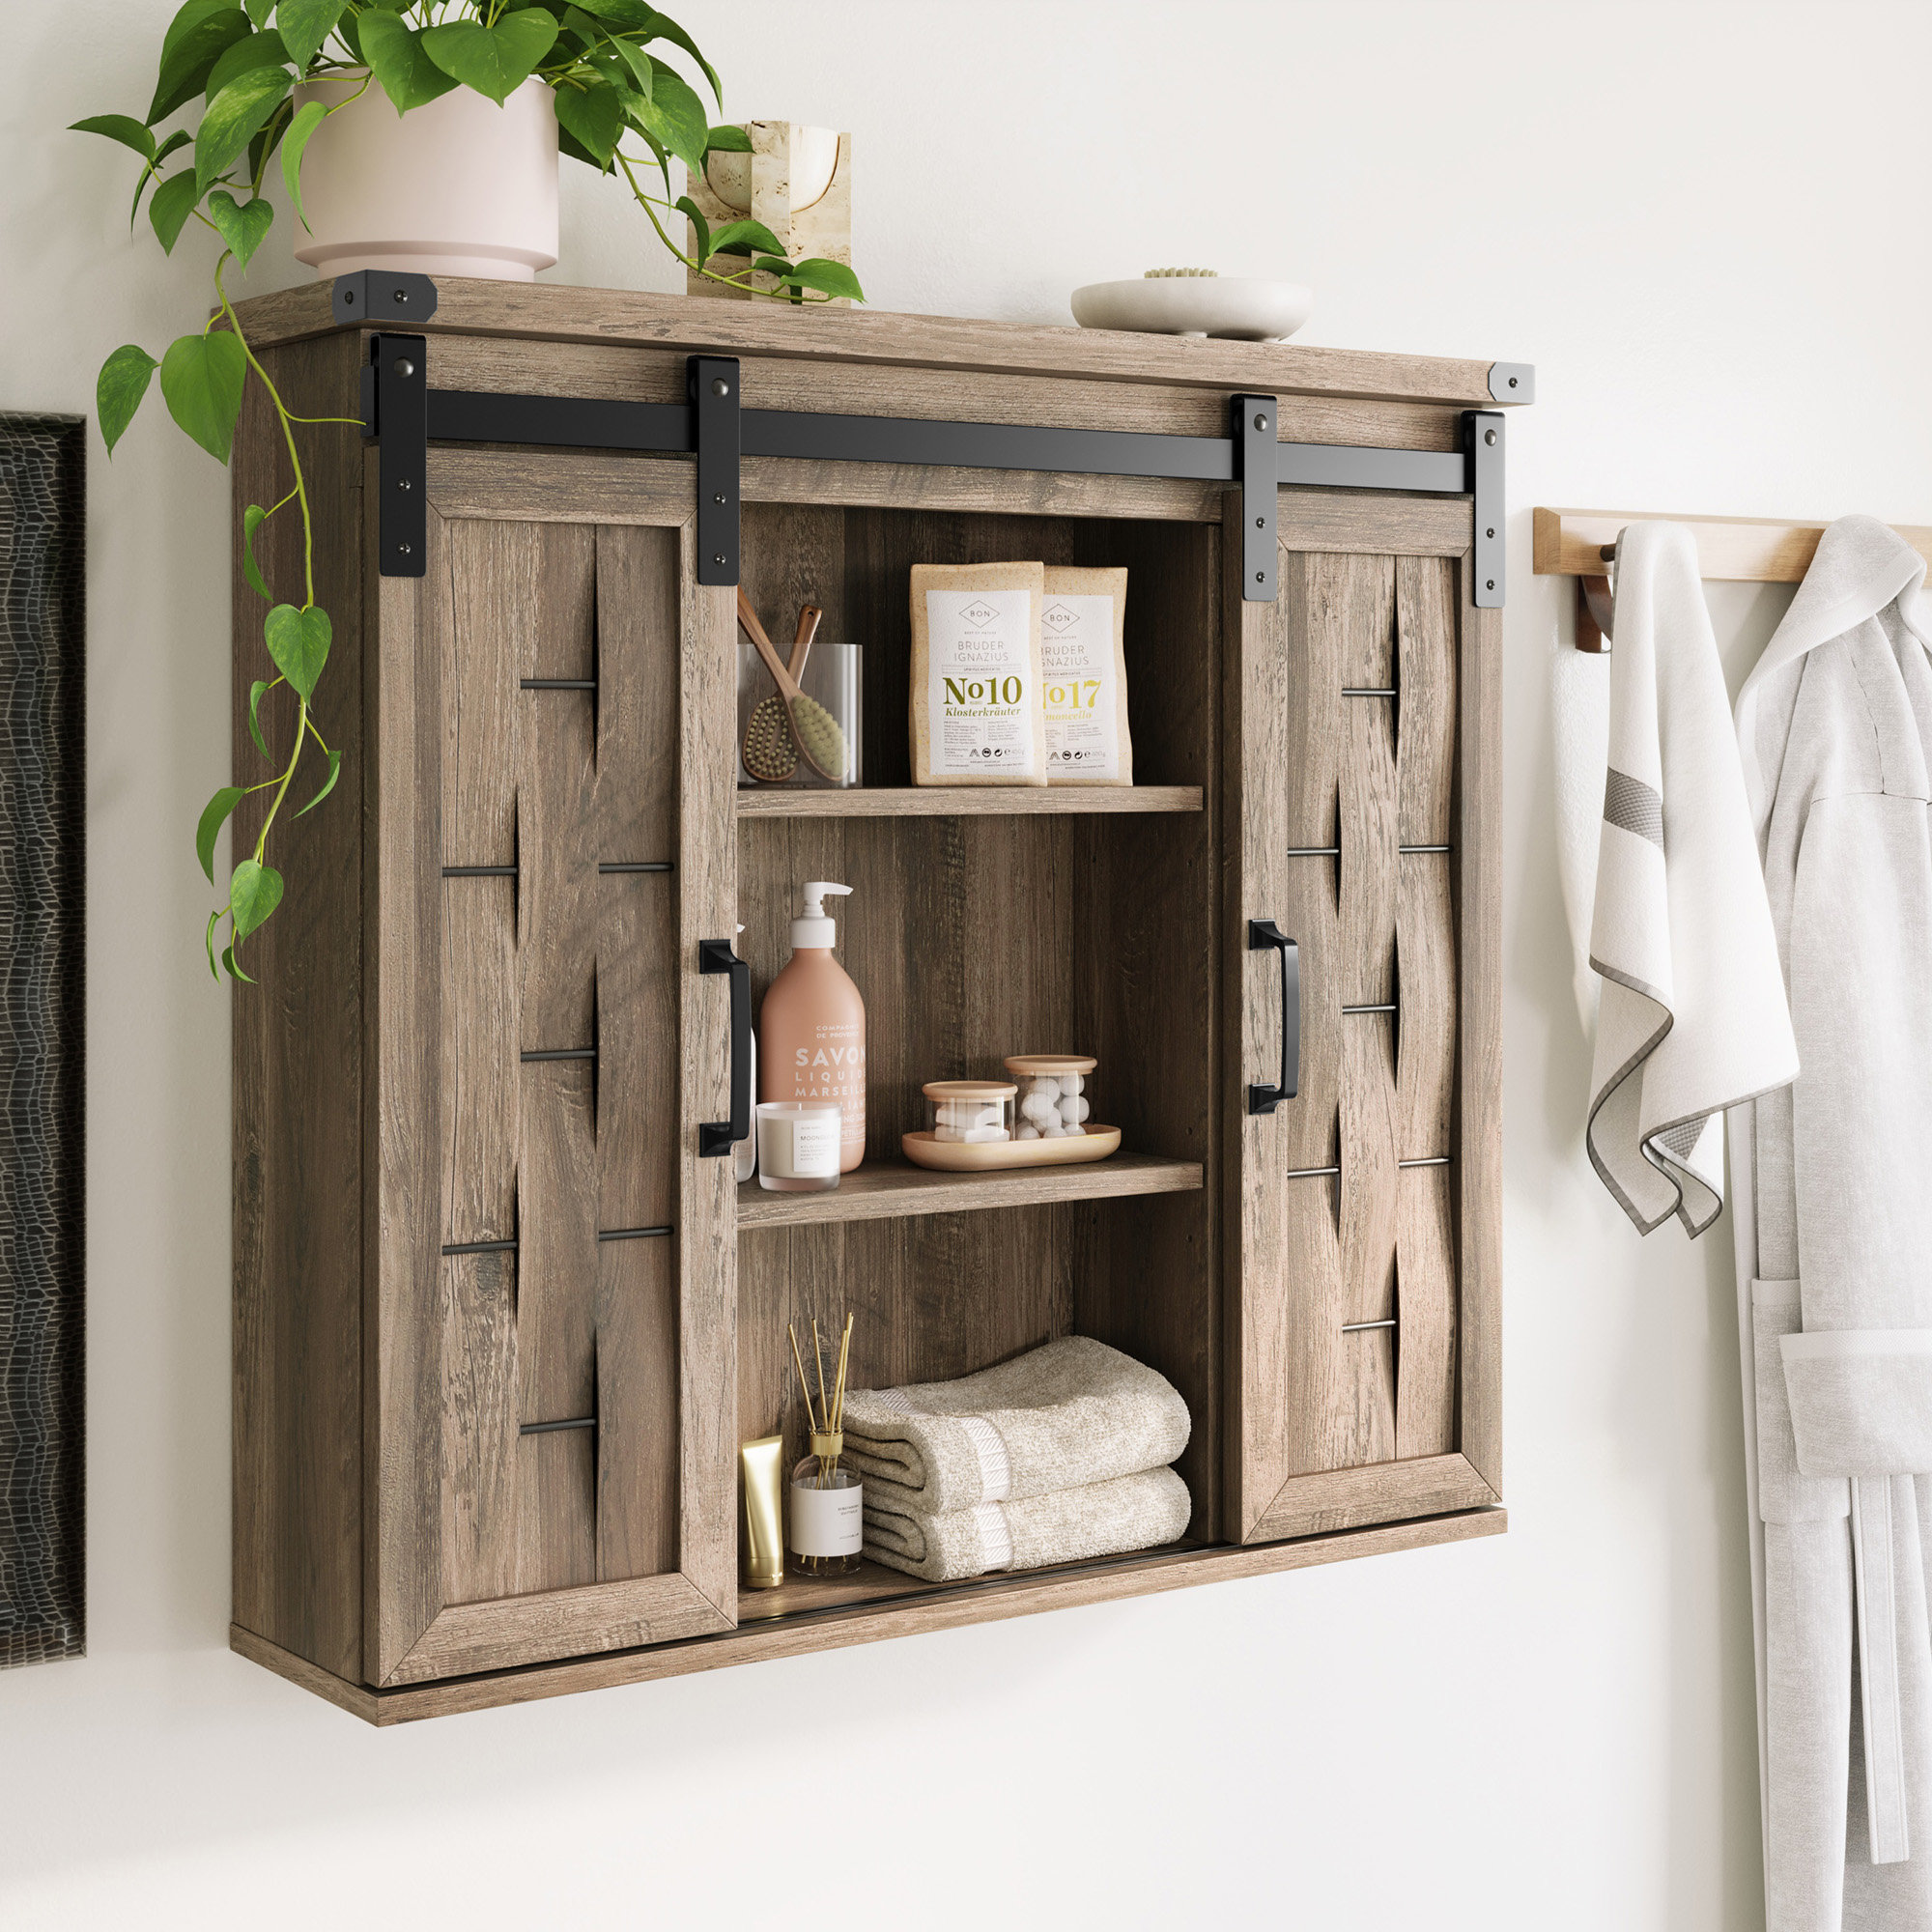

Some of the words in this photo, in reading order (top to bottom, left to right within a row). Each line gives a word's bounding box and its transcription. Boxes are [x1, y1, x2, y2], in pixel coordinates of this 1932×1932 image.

[957, 640, 1005, 651] BRUDER
[953, 652, 1009, 662] IGNAZIUS
[1042, 656, 1090, 667] NAZIUS
[946, 706, 1021, 717] Klosterkräuter
